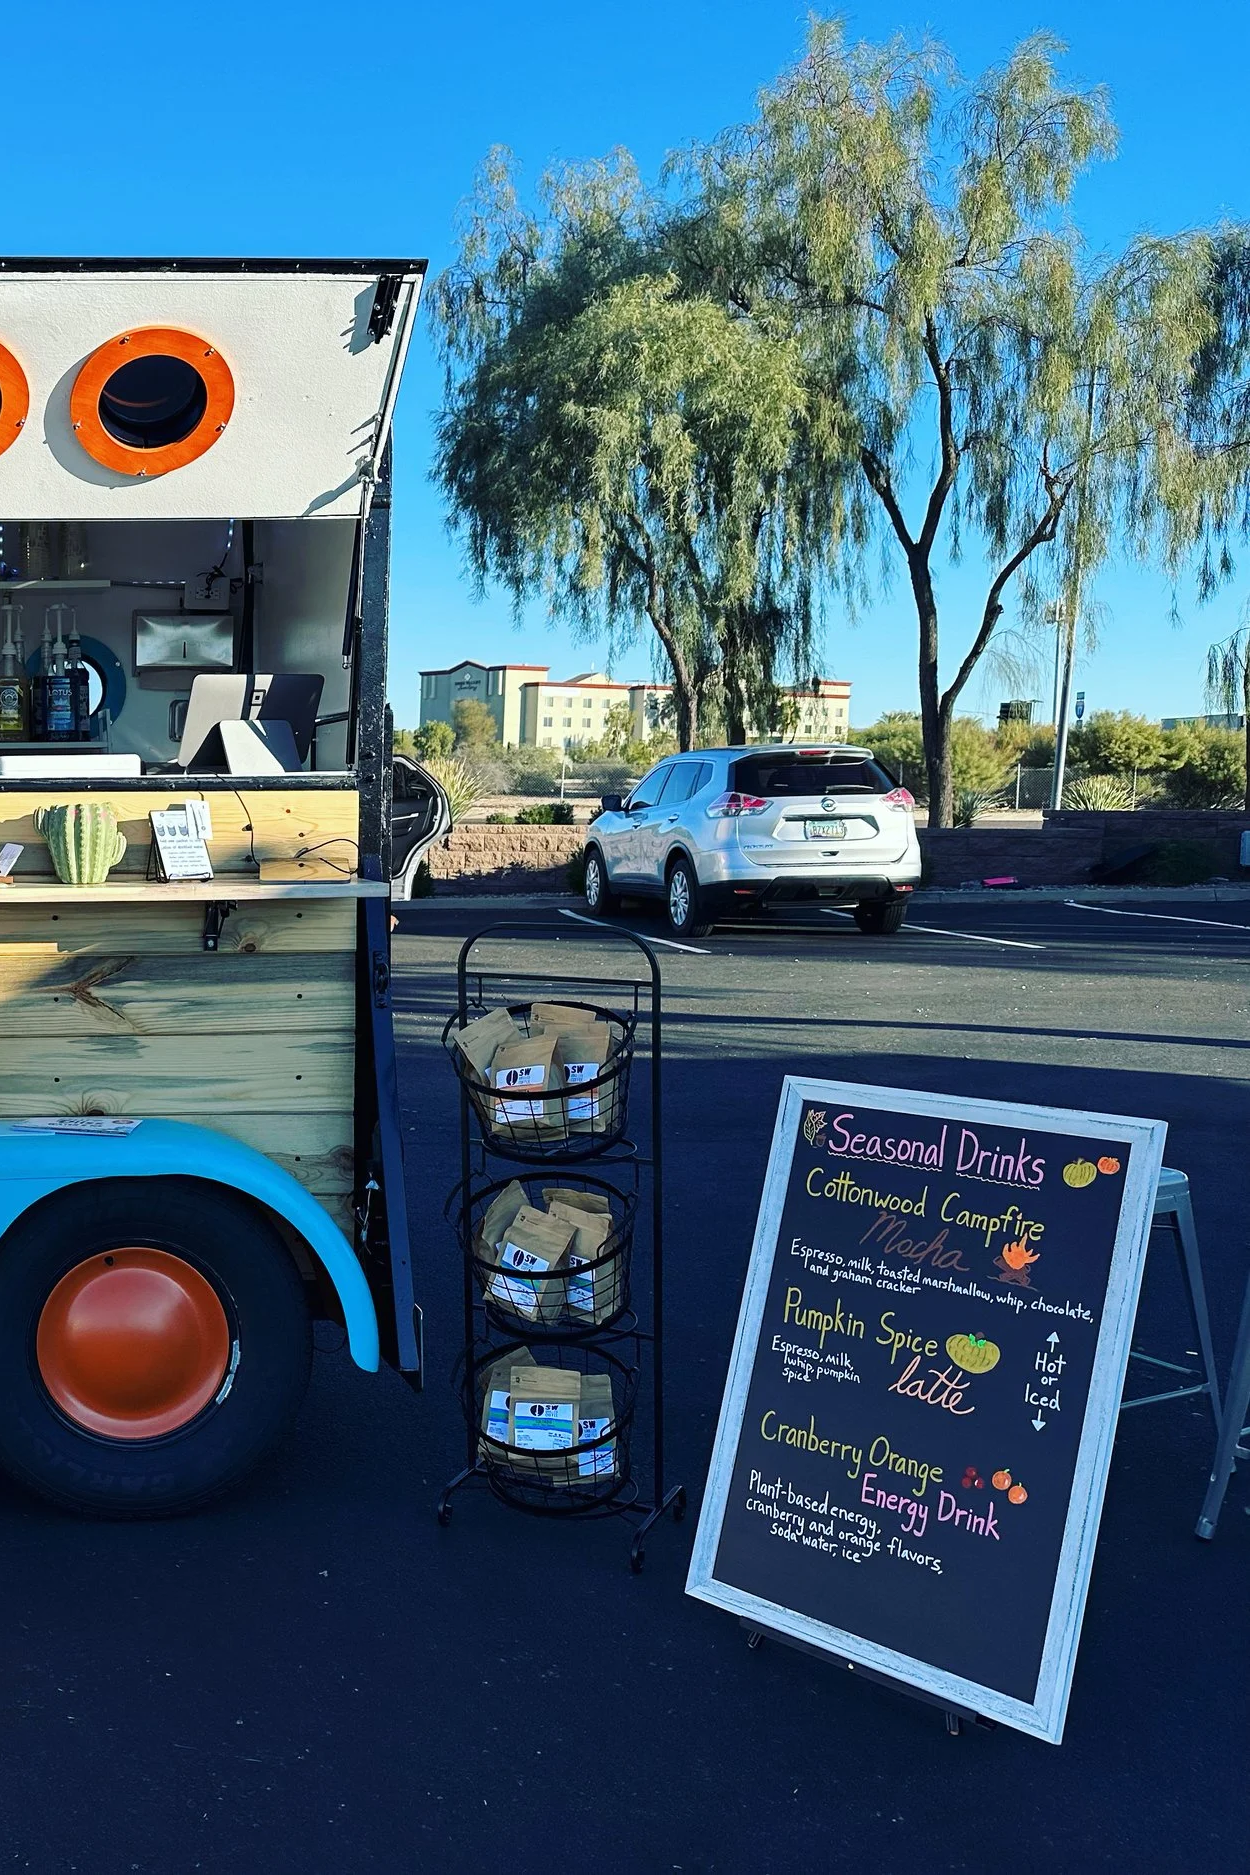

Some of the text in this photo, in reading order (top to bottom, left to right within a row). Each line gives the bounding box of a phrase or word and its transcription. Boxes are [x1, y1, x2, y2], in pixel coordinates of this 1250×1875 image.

[48, 689, 73, 697] LOTUS
[519, 1067, 532, 1077] SW
[571, 1065, 584, 1074] SW
[827, 1113, 1046, 1185] Seasonal Drinks
[806, 1167, 1045, 1248] Cottonwood Campfire
[859, 1210, 970, 1272] Mocha
[524, 1254, 538, 1264] SW
[791, 1238, 1094, 1324] Espresso, milk, toasted marshmallow, whip, chocolate,
[810, 1260, 921, 1296] and graham cracker
[784, 1286, 938, 1364] Pumpkin Spice
[772, 1334, 823, 1364] Espresso,
[1034, 1352, 1066, 1374] Hot
[782, 1368, 812, 1383] spice
[788, 1356, 861, 1384] whip, pumpkin
[888, 1355, 976, 1416] latte
[1040, 1374, 1058, 1386] or
[1024, 1387, 1061, 1412] Iced
[583, 1420, 596, 1428] SW
[760, 1410, 944, 1497] Cranberry Orange
[750, 1470, 882, 1537] Plant-based energy,
[860, 1472, 1001, 1541] Energy Drink
[746, 1498, 944, 1576] cranberry and orange flavors,
[802, 1532, 838, 1558] water,
[841, 1544, 862, 1564] ice
